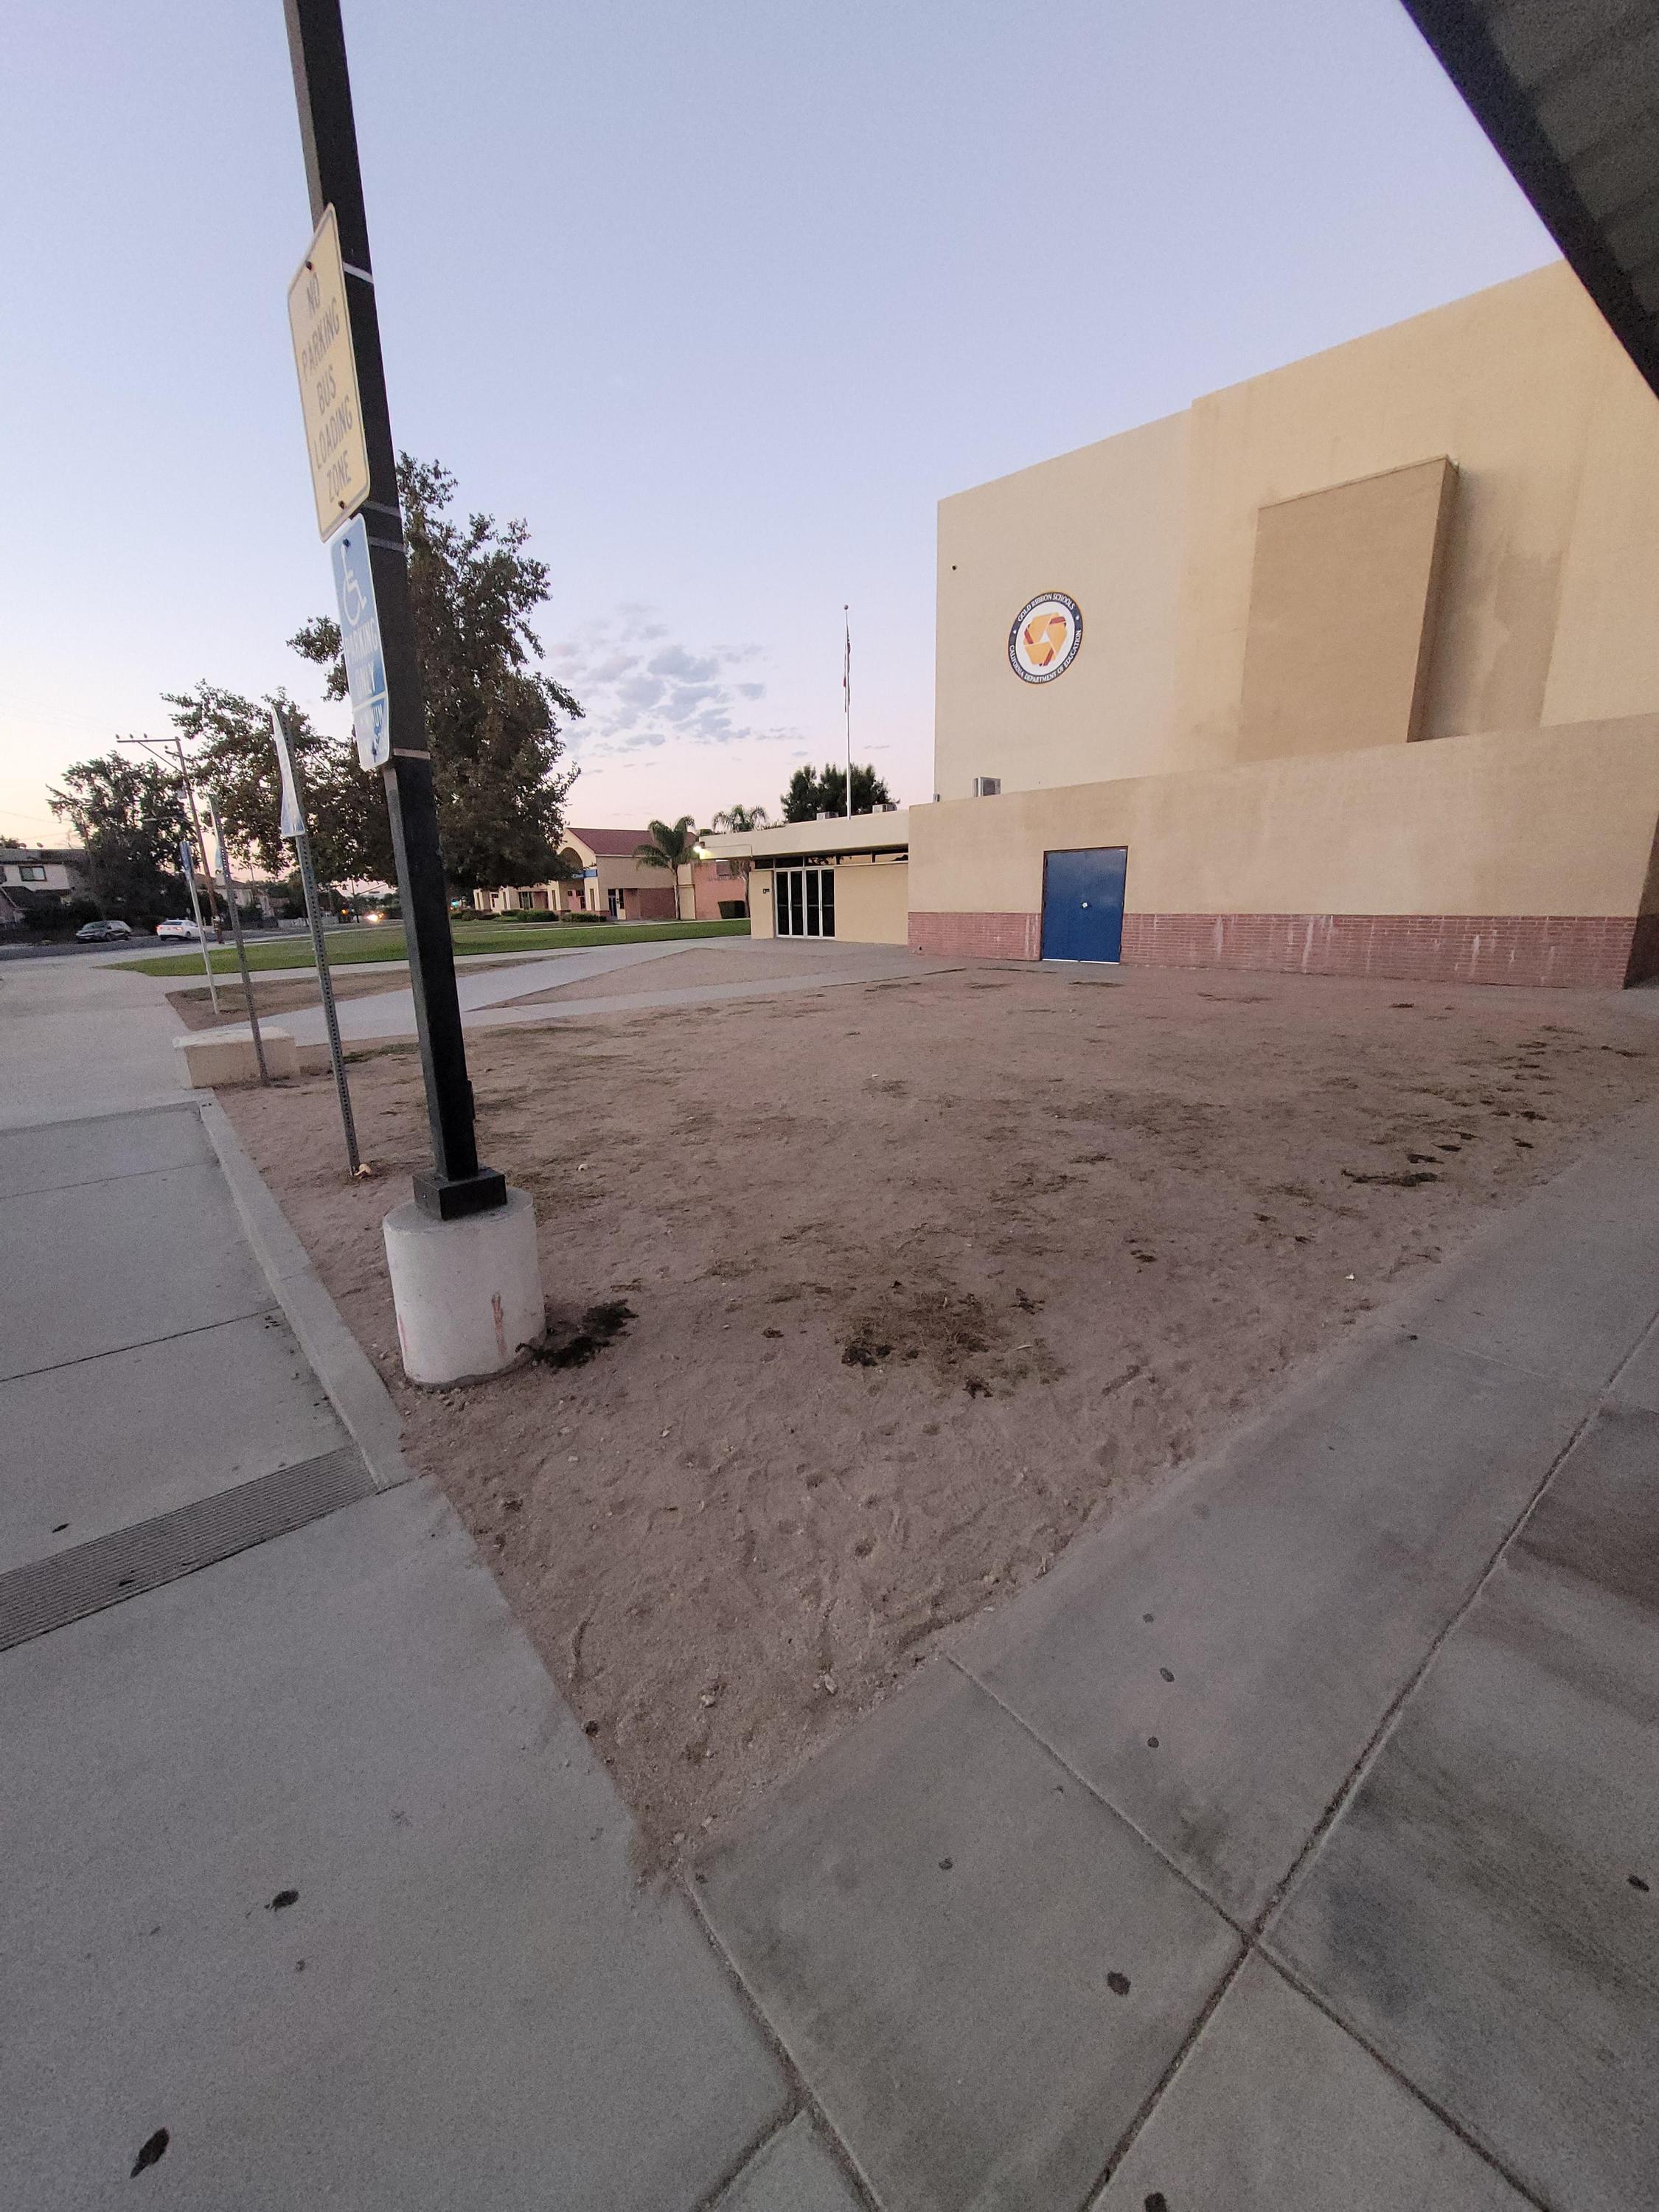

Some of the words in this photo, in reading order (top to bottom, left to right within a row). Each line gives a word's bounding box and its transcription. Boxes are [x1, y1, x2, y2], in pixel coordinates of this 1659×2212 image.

[307, 271, 320, 319] NO
[302, 296, 340, 382] PARKING
[316, 365, 336, 414] BUS
[314, 394, 352, 470] LOADING
[327, 449, 351, 503] ZONE
[1018, 604, 1032, 622] GOLD
[1032, 593, 1053, 607] RIBBON
[1052, 593, 1075, 611] SCHOOLS
[1009, 644, 1024, 677] CALIFORNIA
[1024, 671, 1057, 684] DEPARTMENT
[1057, 665, 1065, 674] OF
[1064, 629, 1082, 668] EDUCATION
